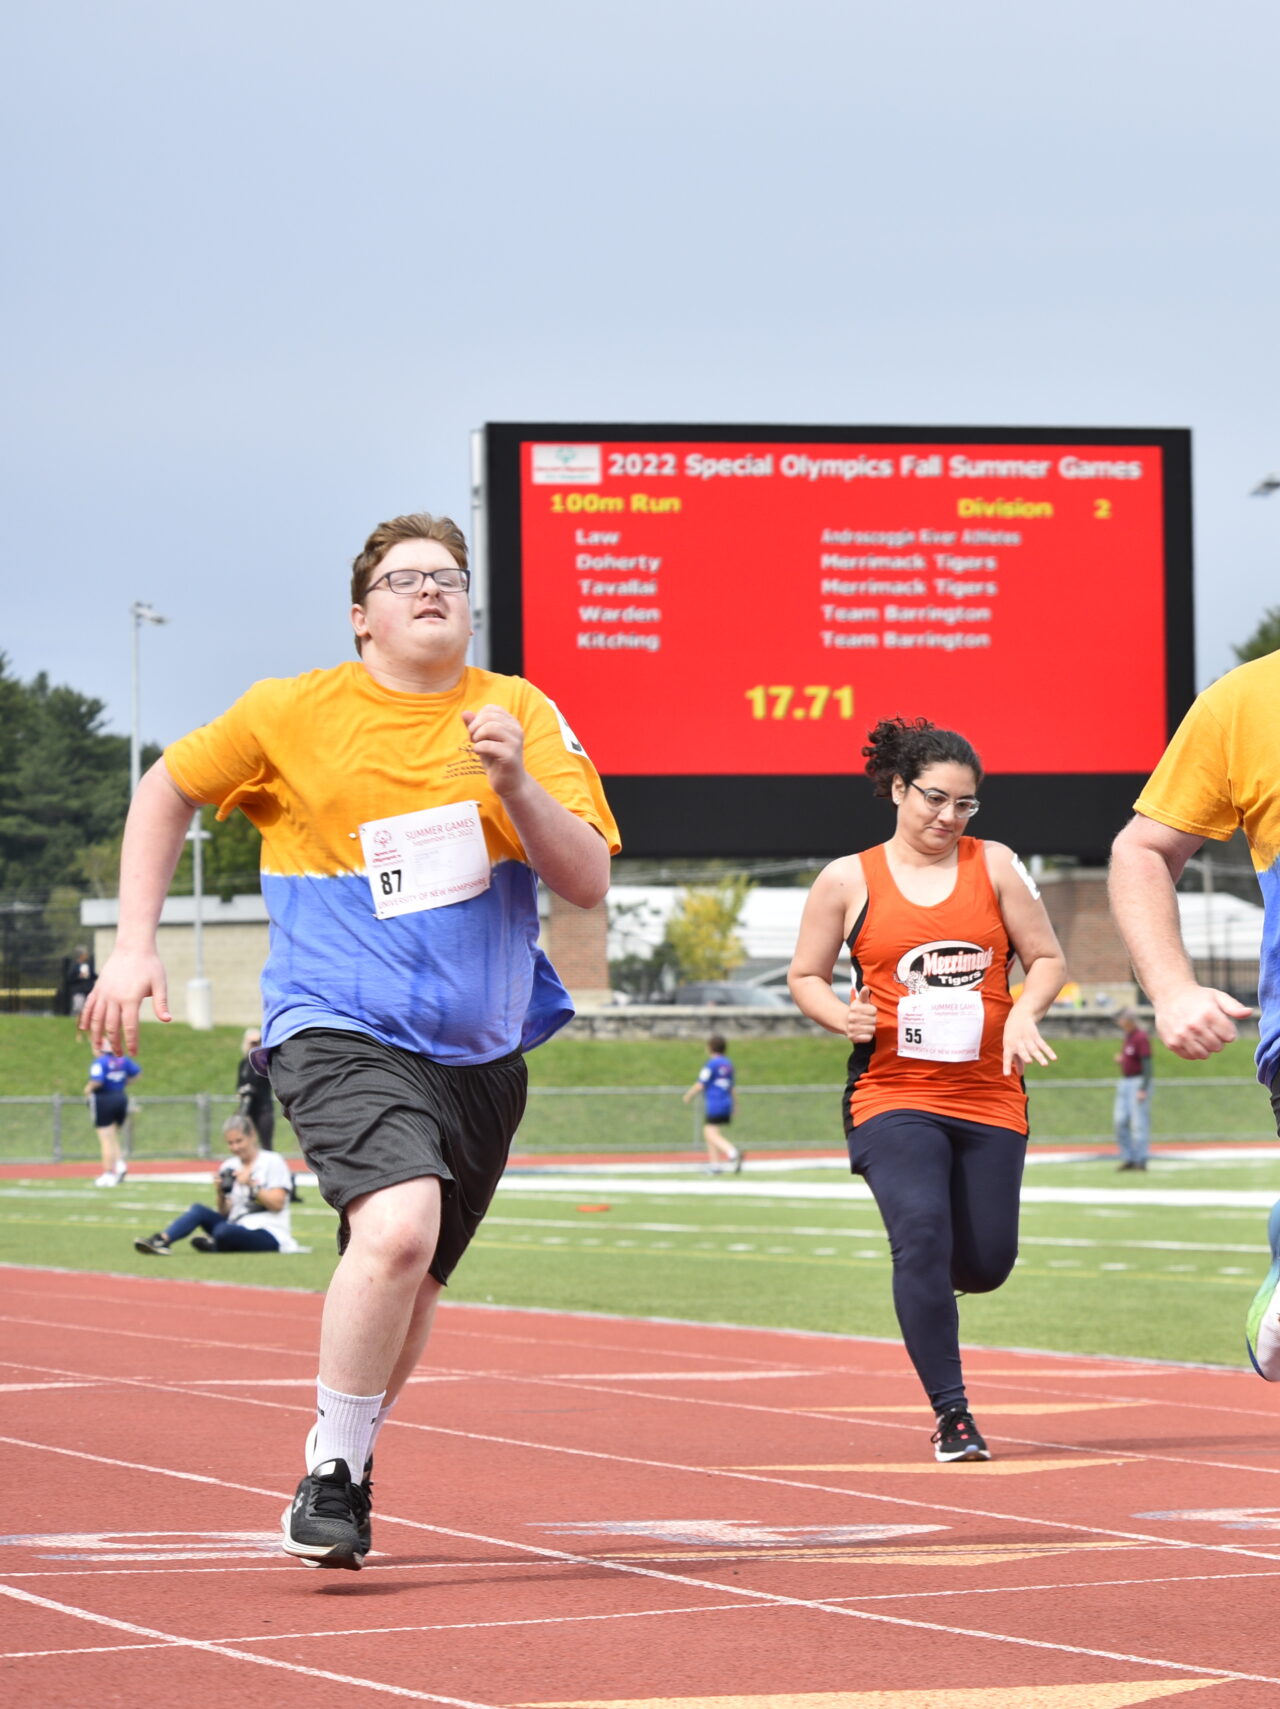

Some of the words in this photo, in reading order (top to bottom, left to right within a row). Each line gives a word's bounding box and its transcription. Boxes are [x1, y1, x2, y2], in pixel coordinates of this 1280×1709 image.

[608, 453, 677, 476] 2022
[685, 453, 773, 479] Special
[780, 454, 894, 481] Olympics
[900, 454, 943, 477] Fall
[948, 455, 1051, 478] Summer
[1058, 456, 1143, 479] Games
[551, 493, 623, 513] 100m
[630, 493, 681, 513] Run
[957, 497, 1054, 519] Division
[1093, 498, 1111, 519] 2
[575, 529, 620, 545] Law
[575, 554, 661, 572] Doherty
[821, 553, 926, 571] Merrimack
[934, 553, 997, 574] Tigers
[821, 578, 926, 596] Merrimack
[934, 578, 997, 599] Tigers
[578, 606, 661, 623] Warden
[820, 604, 879, 622] Team
[883, 604, 992, 626] Barrington
[577, 633, 660, 651] Kitching
[820, 630, 879, 648] Team
[882, 630, 992, 652] Barrington
[745, 686, 853, 719] 17.71
[405, 824, 443, 840] SUMMER
[445, 817, 476, 832] GAMES
[380, 869, 402, 895] 87
[430, 888, 446, 897] NEW
[922, 946, 993, 977] Merrimack
[938, 971, 982, 986] Tigers
[905, 1027, 922, 1045] 55
